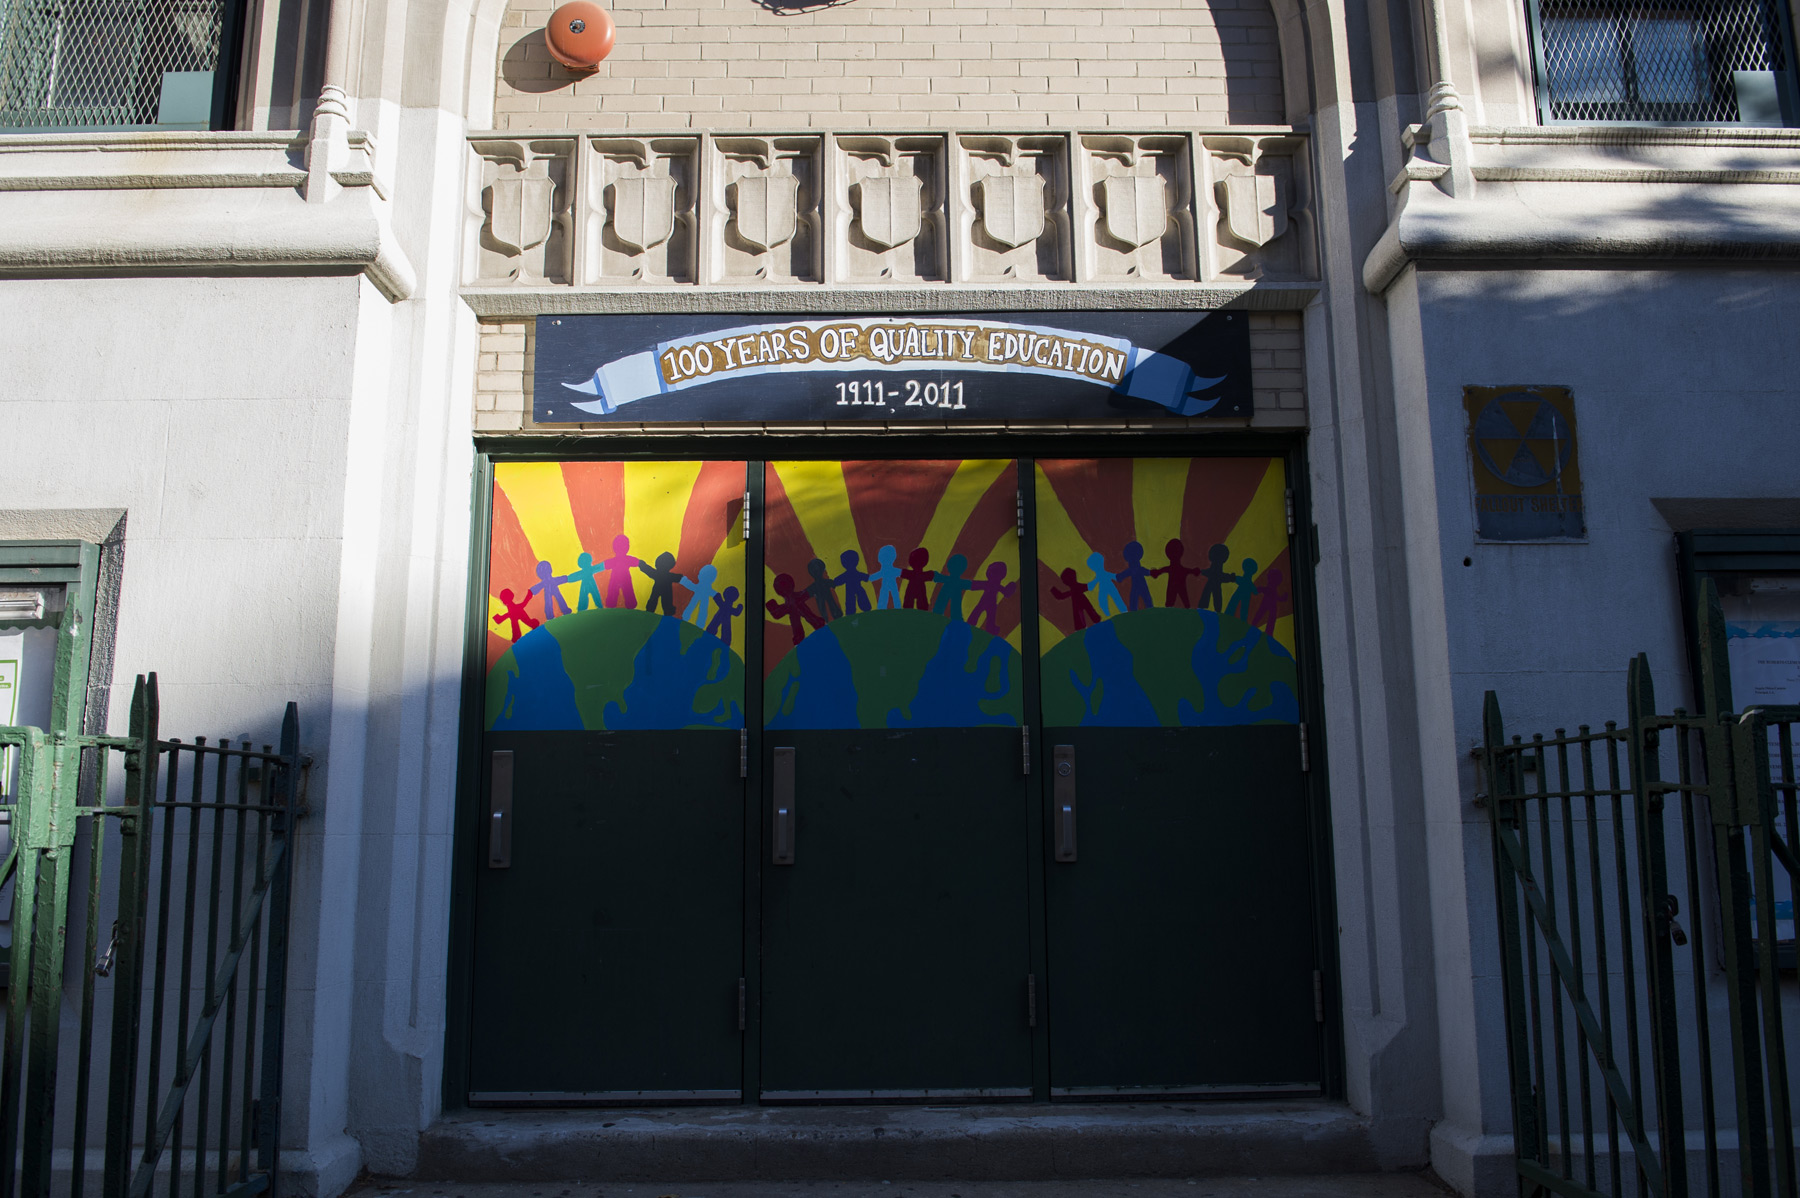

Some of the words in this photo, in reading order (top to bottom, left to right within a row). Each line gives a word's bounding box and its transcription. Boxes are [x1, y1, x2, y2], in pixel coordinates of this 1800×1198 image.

[663, 343, 713, 381] 100
[714, 329, 811, 370] YEARS
[820, 327, 858, 359] OF
[869, 326, 976, 361] QUALITY
[987, 331, 1127, 382] EDUCATION
[1475, 496, 1525, 513] FALLOUT
[1531, 496, 1583, 513] SHELTER
